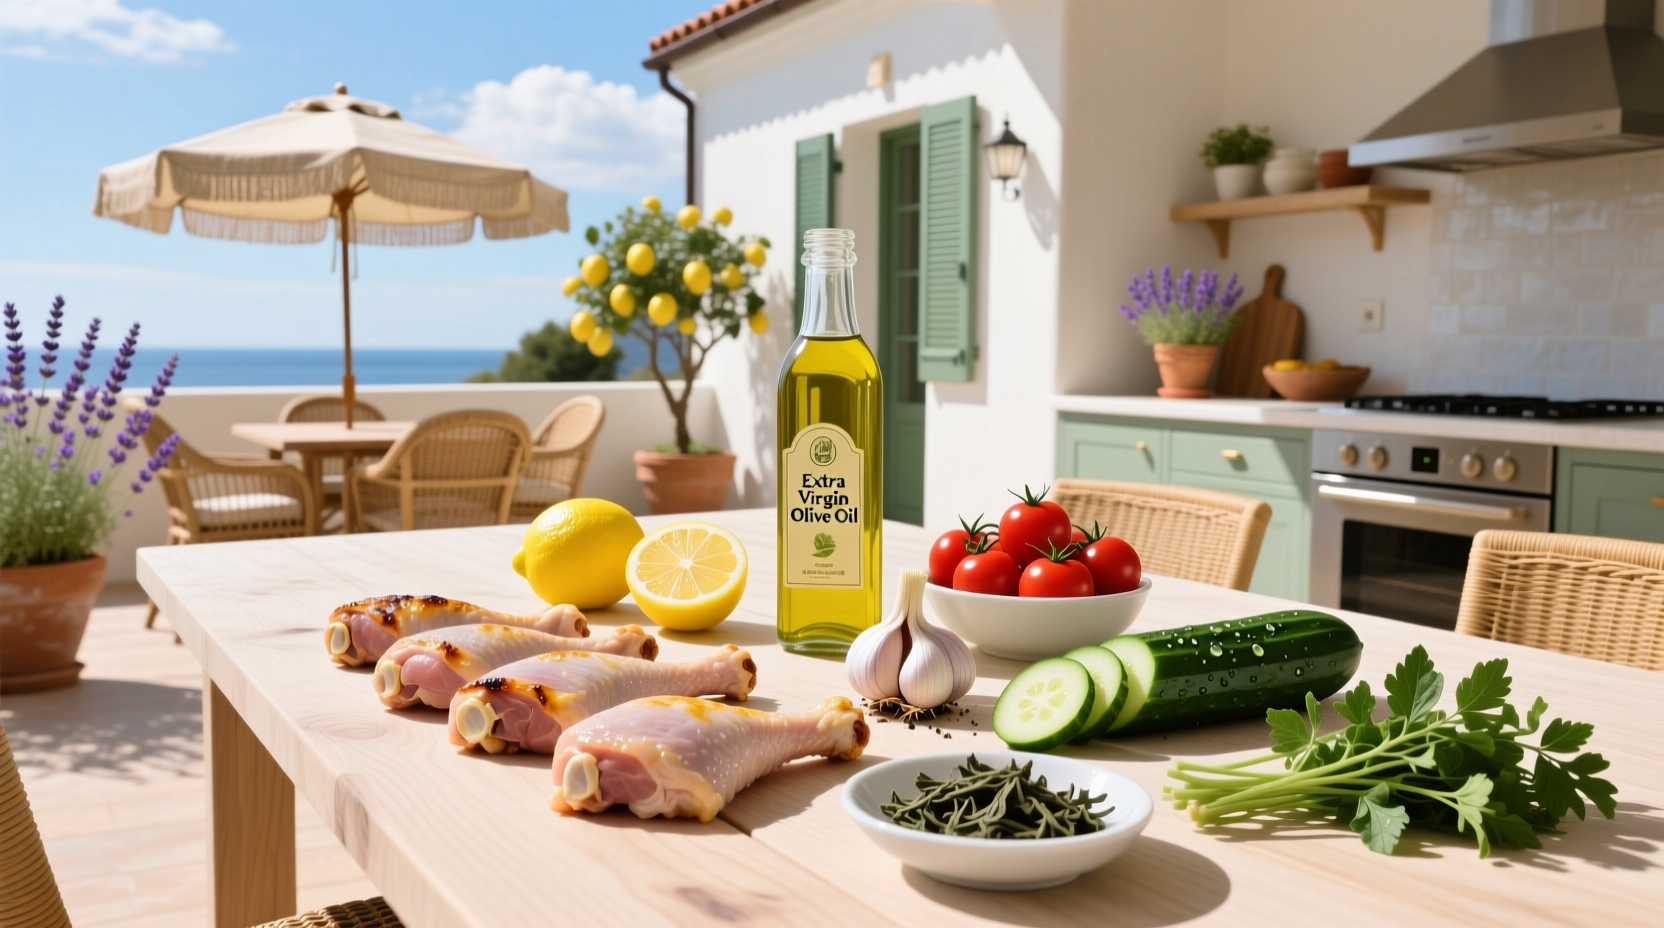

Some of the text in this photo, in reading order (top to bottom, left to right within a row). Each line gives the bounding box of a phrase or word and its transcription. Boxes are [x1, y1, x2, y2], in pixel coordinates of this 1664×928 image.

[802, 473, 845, 488] Extra
[798, 490, 849, 509] Virgin
[791, 507, 858, 523] Olive Oil
